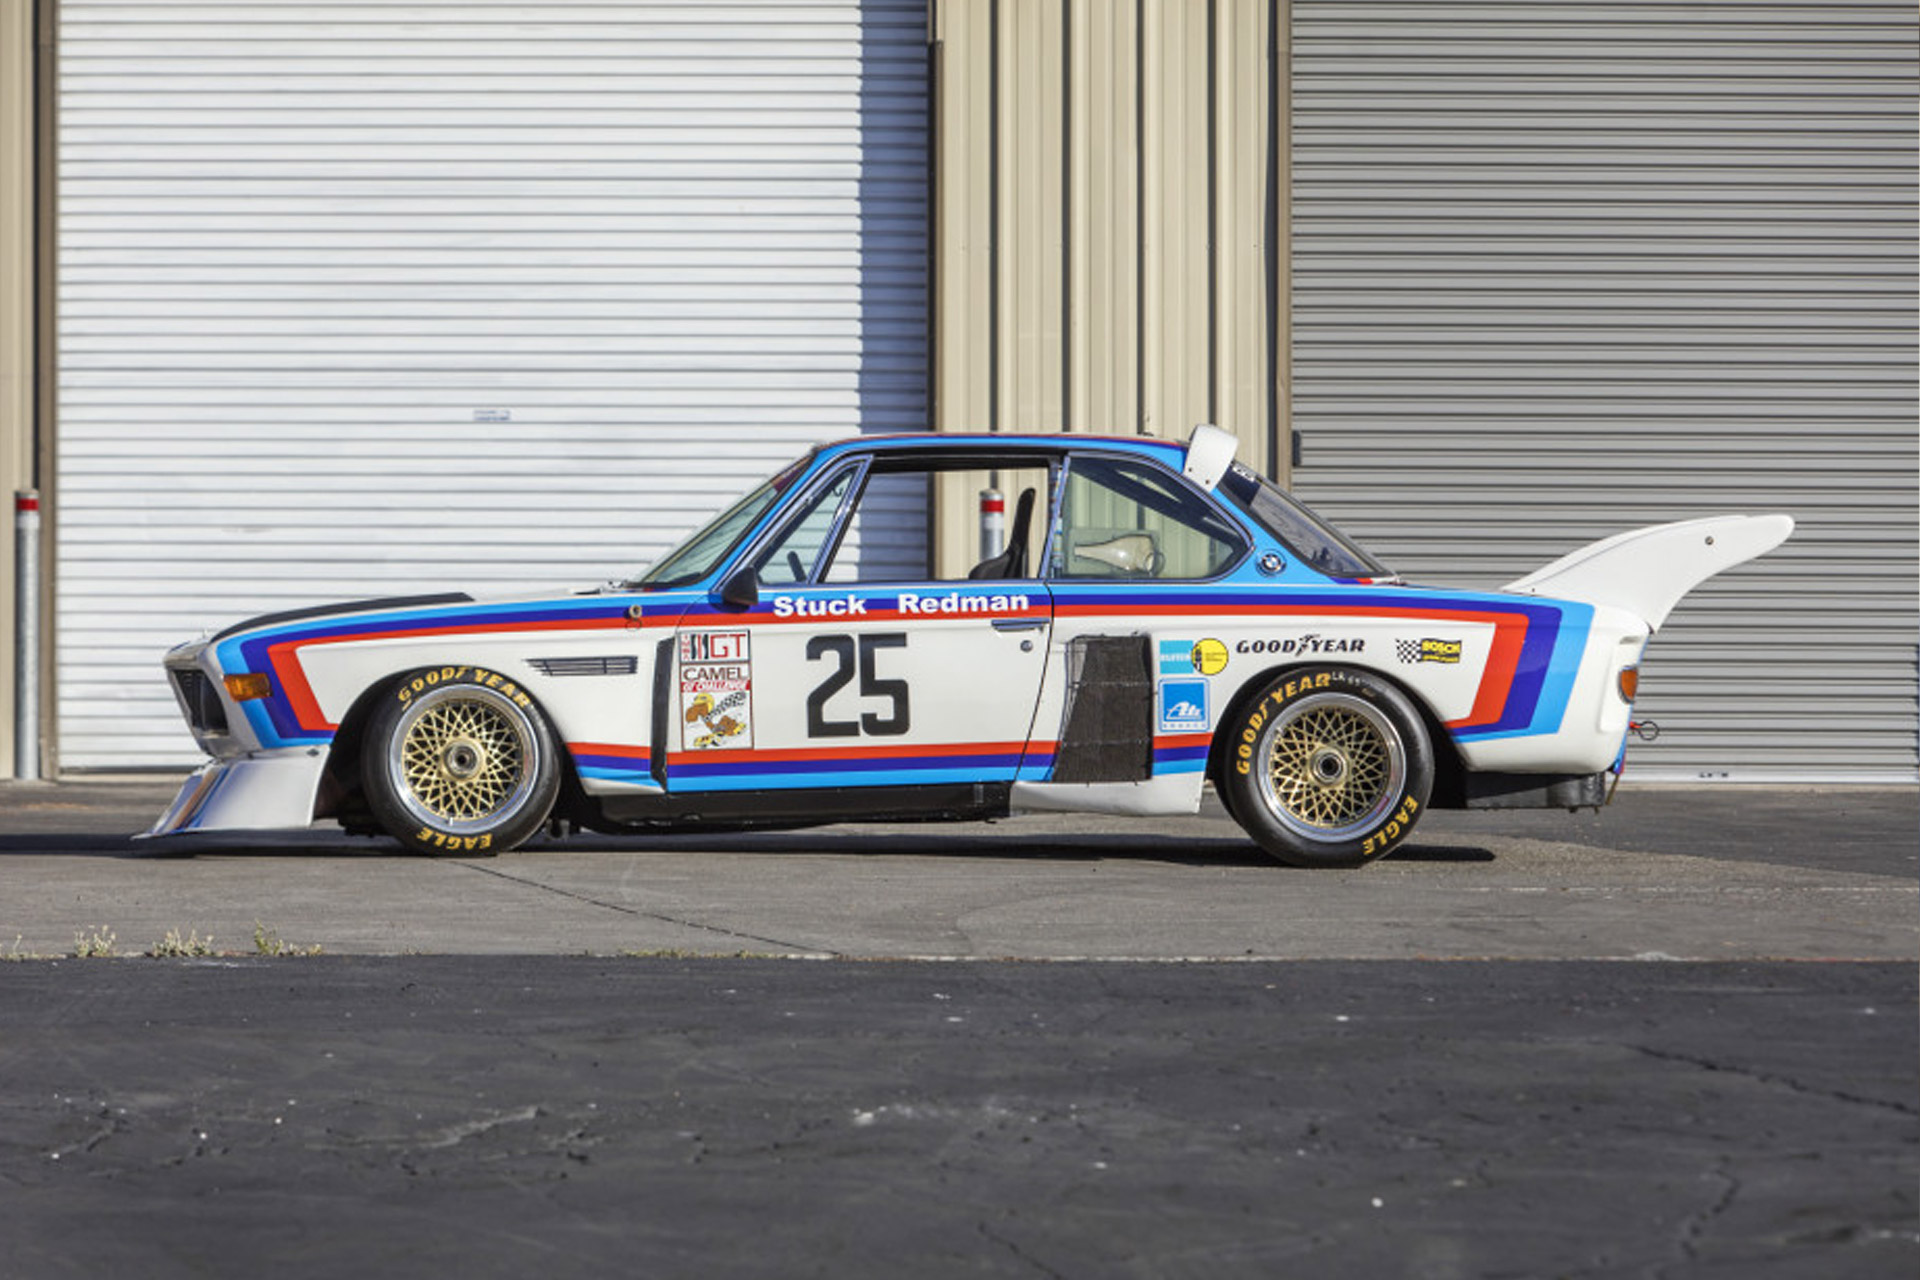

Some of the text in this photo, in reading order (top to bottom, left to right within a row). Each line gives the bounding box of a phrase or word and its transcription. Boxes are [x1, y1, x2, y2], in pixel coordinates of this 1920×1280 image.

[773, 592, 1030, 617] Stuck Redman
[710, 633, 746, 658] GT
[1236, 635, 1366, 656] GOODYEAR
[683, 666, 749, 681] CAMEL
[805, 632, 910, 738] 25
[1362, 795, 1419, 855] EAGLE
[416, 827, 494, 850] EAGLE
